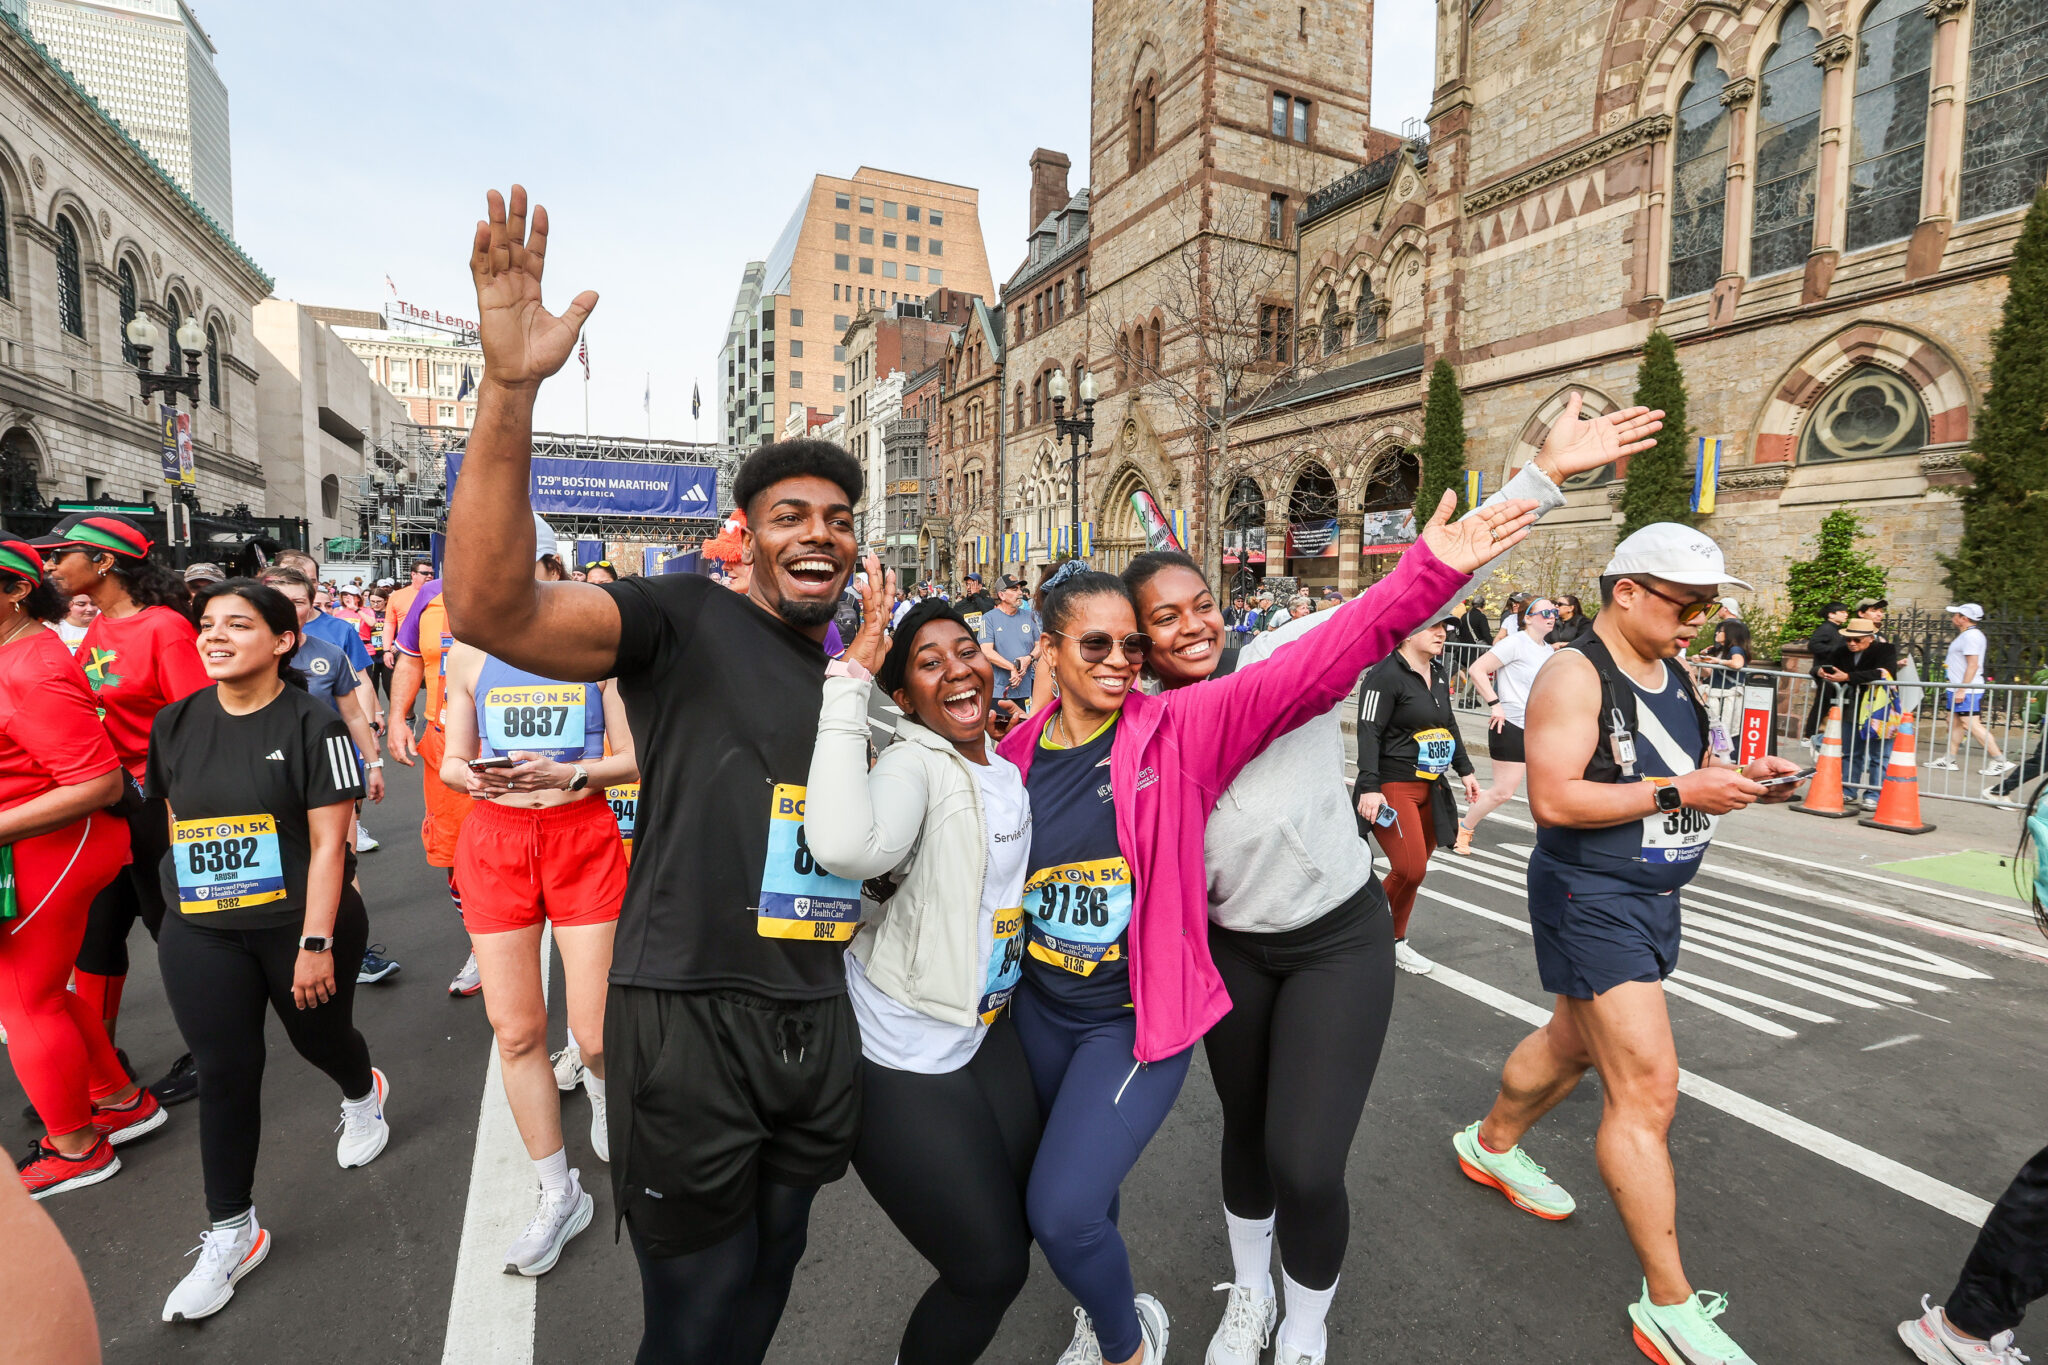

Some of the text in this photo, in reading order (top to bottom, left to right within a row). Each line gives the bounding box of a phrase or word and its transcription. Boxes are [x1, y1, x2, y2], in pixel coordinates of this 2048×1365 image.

[16, 113, 33, 136] AS
[397, 300, 430, 320] The
[562, 476, 606, 489] BOSTON
[608, 479, 669, 491] MARATHON
[538, 488, 615, 498] BANK OF AMERICA
[562, 692, 581, 702] 5K
[504, 706, 568, 738] 9837
[1427, 741, 1450, 759] 6365
[250, 821, 270, 832] 5K
[189, 837, 260, 874] 6382
[214, 871, 238, 881] ARUSHI
[1101, 868, 1124, 881] 5K
[211, 882, 259, 892] Harvard Pilgrim
[211, 889, 232, 897] Health
[217, 897, 240, 909] 6382
[811, 900, 853, 912] Harvard Pilgrim
[1039, 882, 1109, 927] 9136
[811, 908, 844, 918] Health Care
[814, 922, 835, 938] 8842
[1057, 940, 1106, 953] Harvard Pilgrim
[1059, 946, 1093, 959] Health Care
[1063, 955, 1085, 973] 9136
